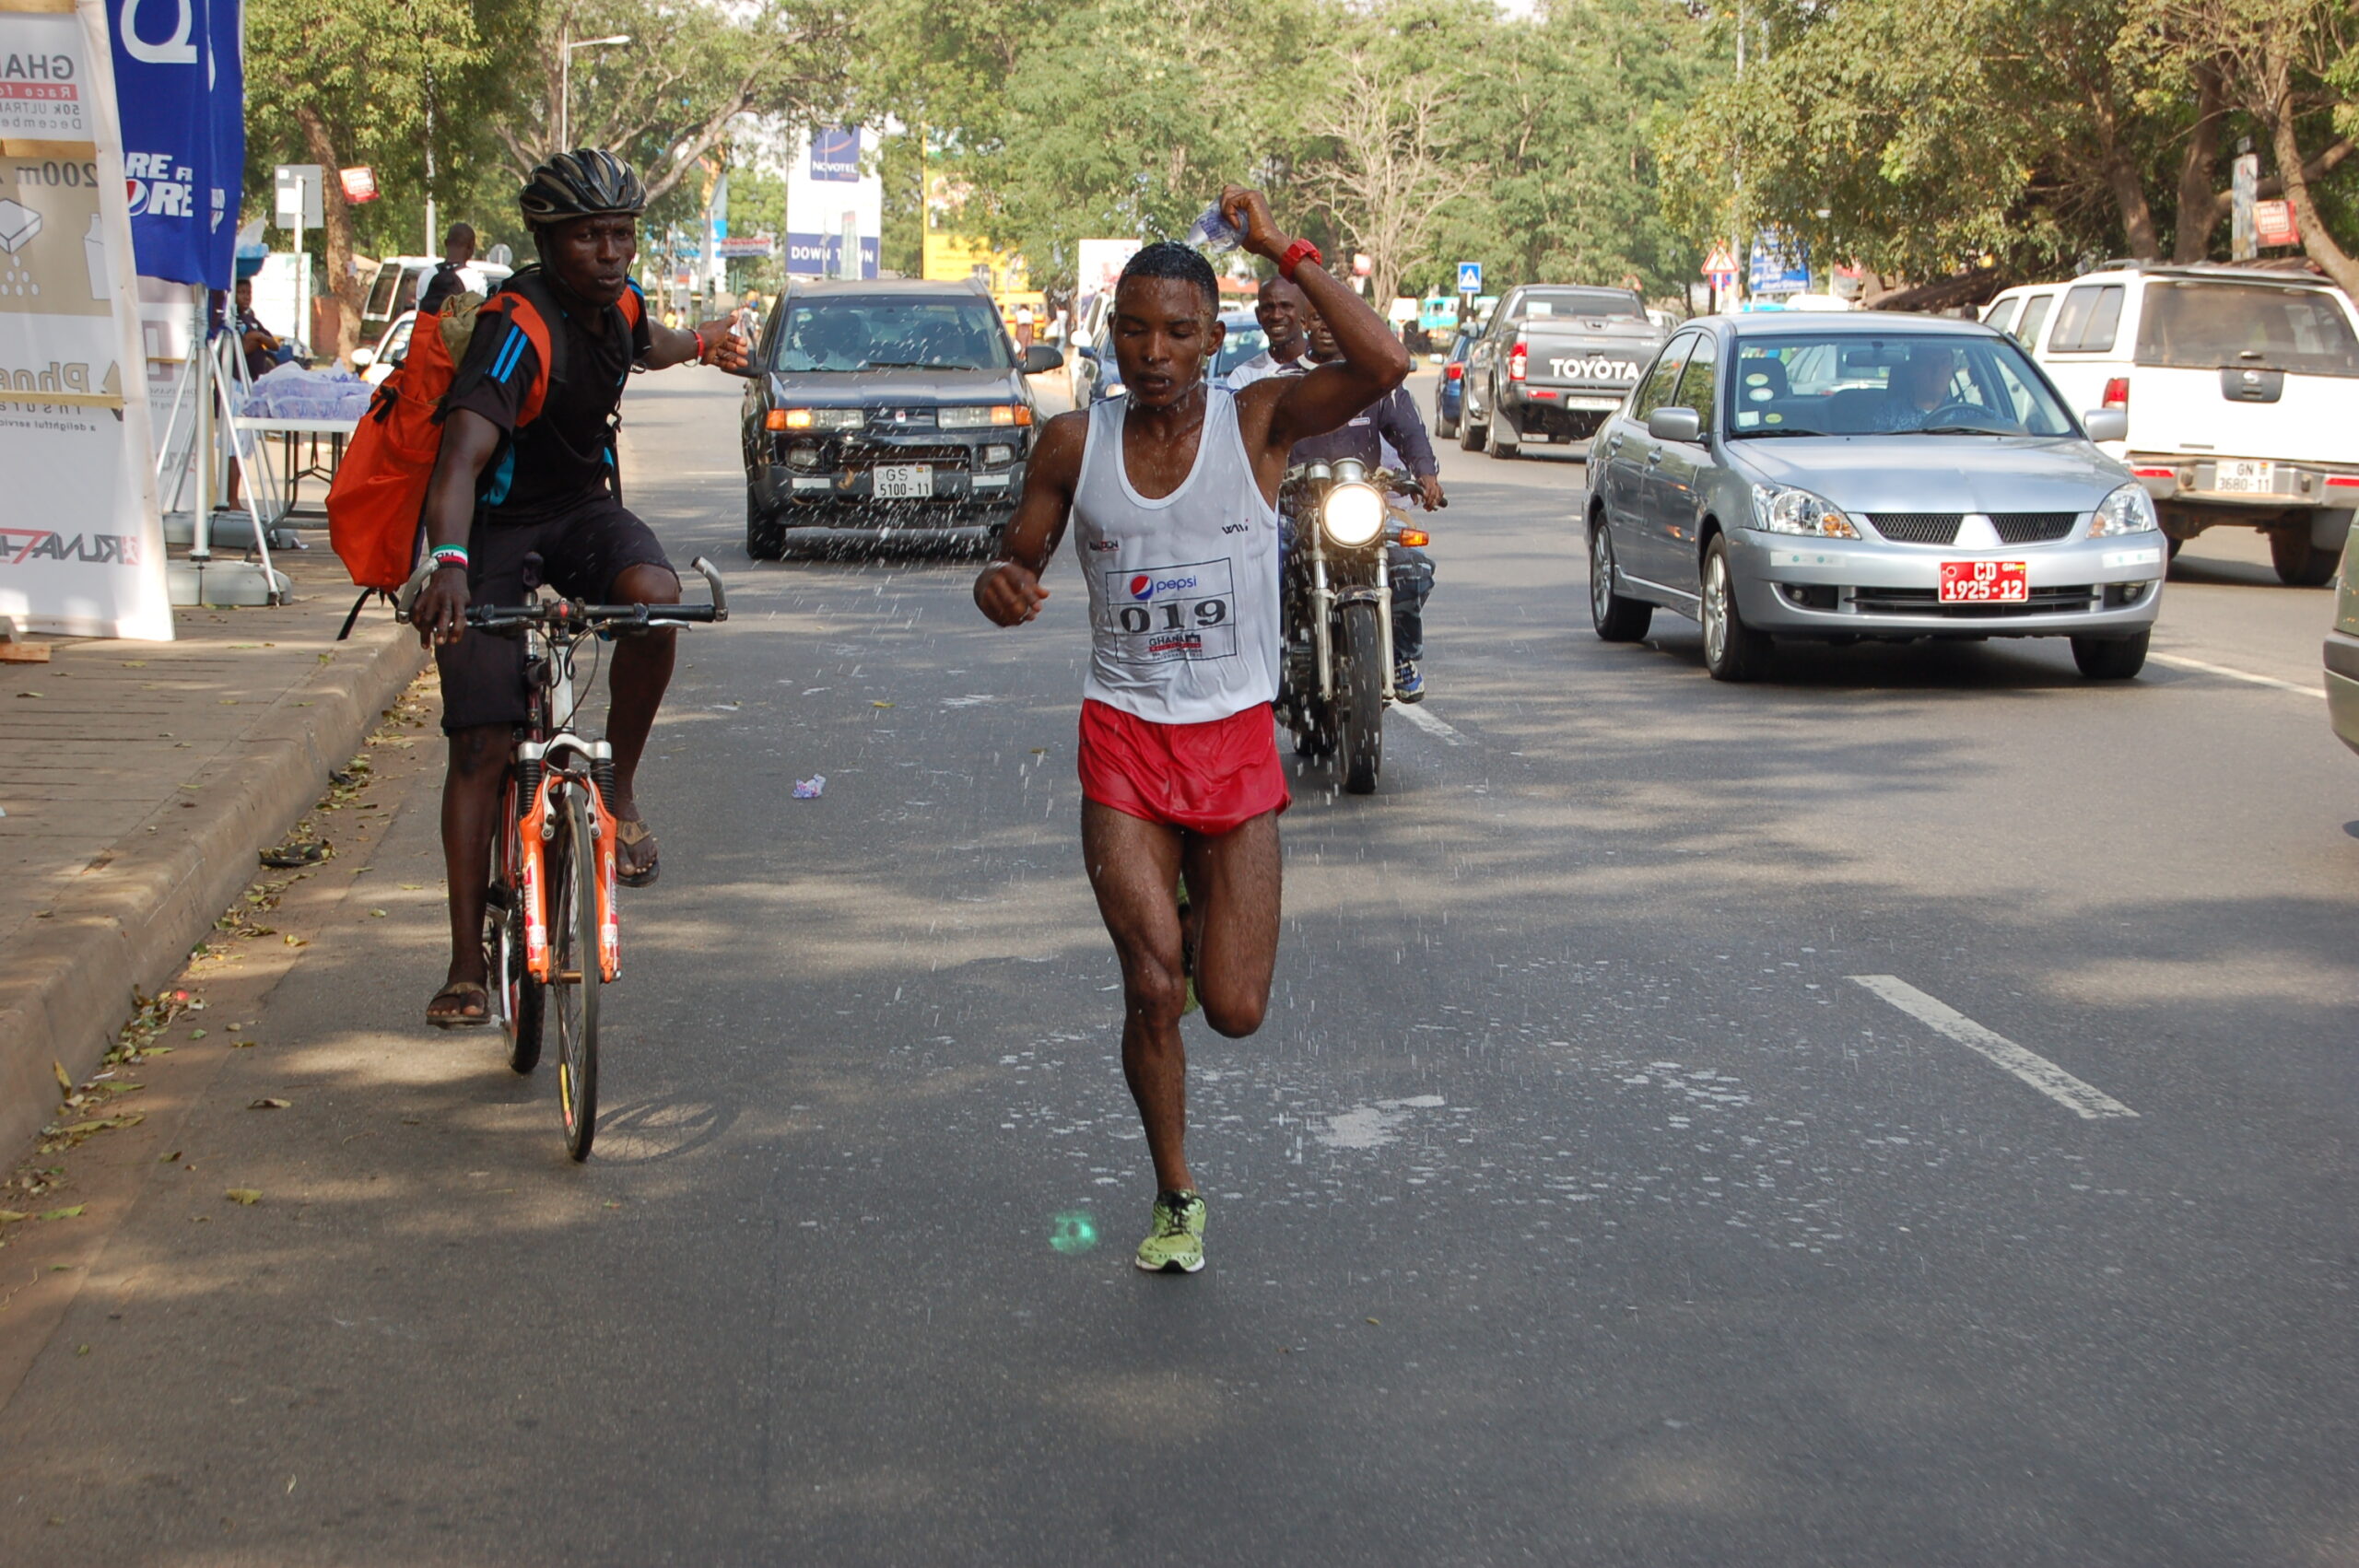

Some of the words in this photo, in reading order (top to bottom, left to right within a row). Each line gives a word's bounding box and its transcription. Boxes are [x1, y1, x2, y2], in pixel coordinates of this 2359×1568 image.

[125, 152, 172, 180] RE
[812, 160, 858, 173] NOVOTEL
[791, 246, 831, 261] DOWN
[1549, 358, 1639, 380] TOYOTA
[886, 468, 908, 482] GS
[2236, 463, 2254, 476] GN
[1974, 562, 1997, 580] CD
[1156, 575, 1197, 592] pepsi
[1945, 579, 2023, 599] 1925-12
[1120, 599, 1226, 634] 019
